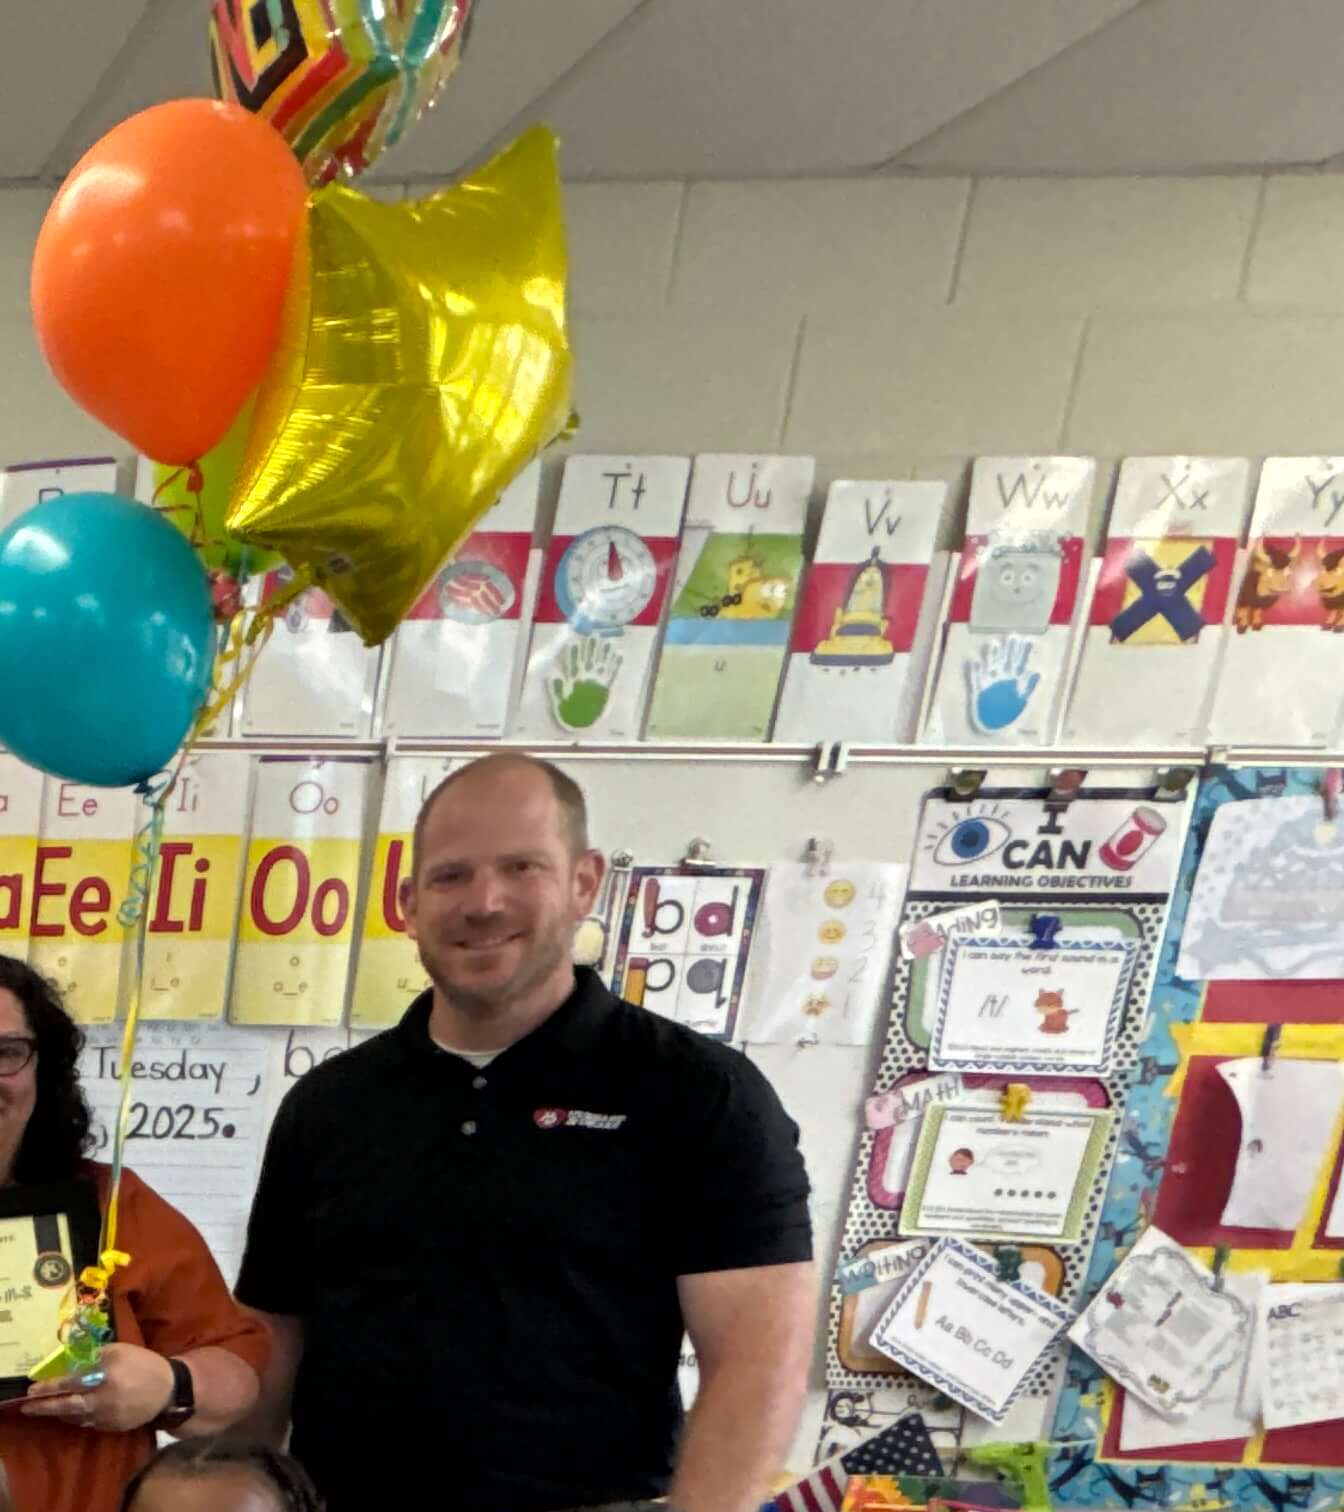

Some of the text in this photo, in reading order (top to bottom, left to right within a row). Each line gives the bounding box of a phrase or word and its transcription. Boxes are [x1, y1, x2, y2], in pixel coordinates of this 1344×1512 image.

[601, 472, 647, 510] Tt
[726, 471, 772, 508] Uu
[996, 472, 1070, 510] Ww
[1155, 473, 1210, 512] Xx
[1305, 474, 1344, 528] Yy
[864, 497, 902, 537] Vv
[57, 781, 99, 817] Ee
[175, 777, 200, 814] Ii
[288, 780, 341, 817] Oo
[1036, 802, 1069, 835] I
[1002, 839, 1093, 870] CAN
[29, 846, 112, 938] Ee
[148, 843, 211, 936] Ii
[249, 845, 351, 938] Oo
[949, 875, 1133, 890] LEARNING OBJECTIVES
[95, 1046, 227, 1095] Tuesday
[124, 1102, 237, 1141] 2025.
